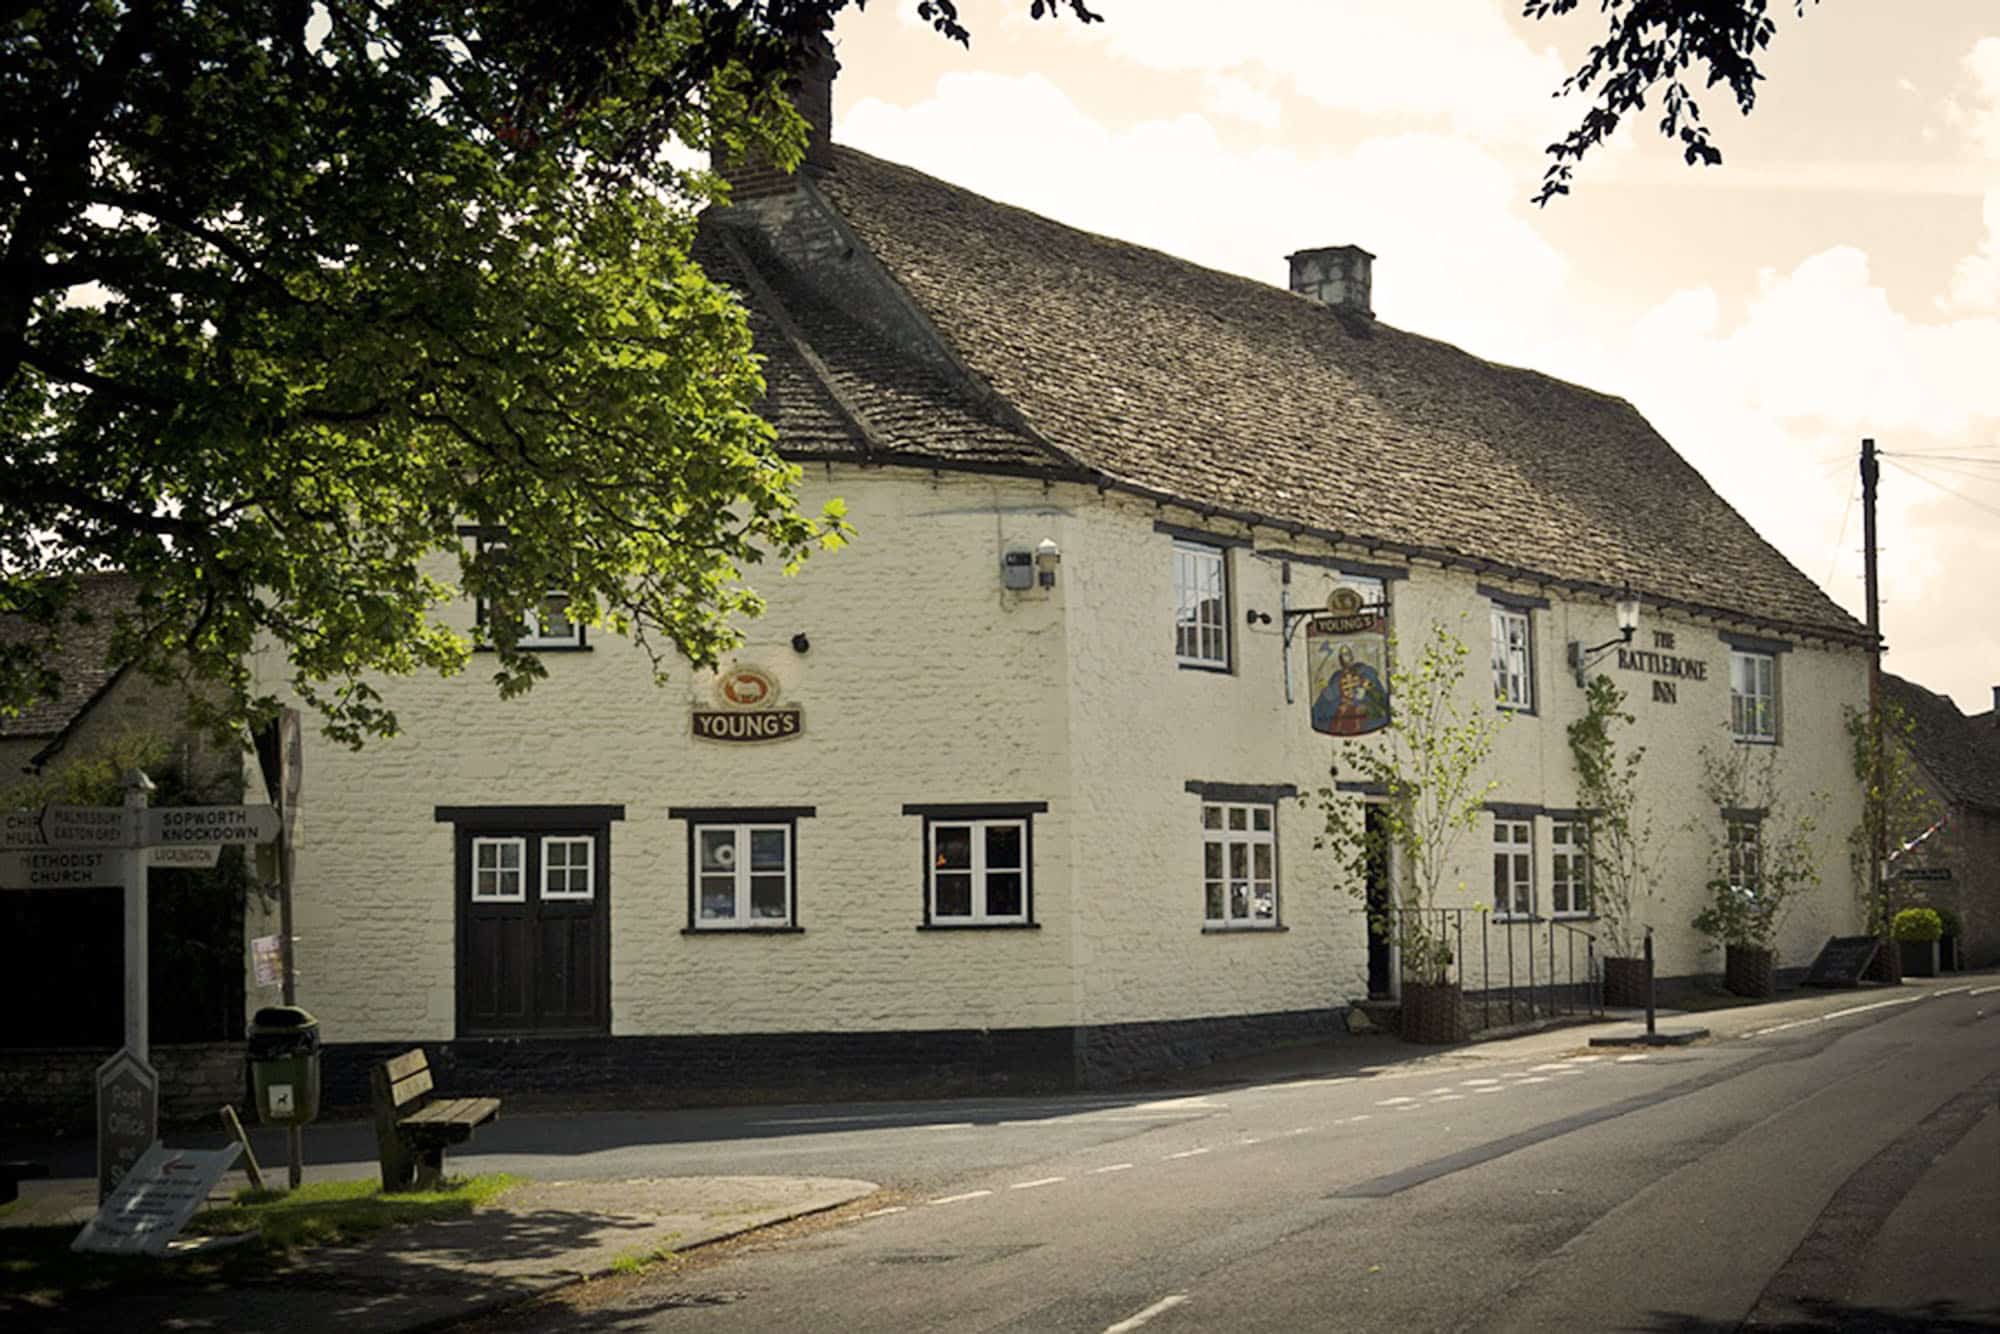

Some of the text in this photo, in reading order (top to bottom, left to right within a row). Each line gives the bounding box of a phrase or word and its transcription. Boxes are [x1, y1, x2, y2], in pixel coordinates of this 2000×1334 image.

[1319, 616, 1374, 633] YOUNG'S
[1652, 629, 1676, 650] THE
[1617, 647, 1708, 681] RATTLEBONE
[1652, 679, 1678, 704] INN
[699, 712, 795, 737] YOUNG'S
[163, 811, 247, 826] SOPWORTH
[161, 826, 258, 841] KNOCKDOWN
[20, 853, 104, 868] METHODIST
[30, 869, 93, 883] CHURCH
